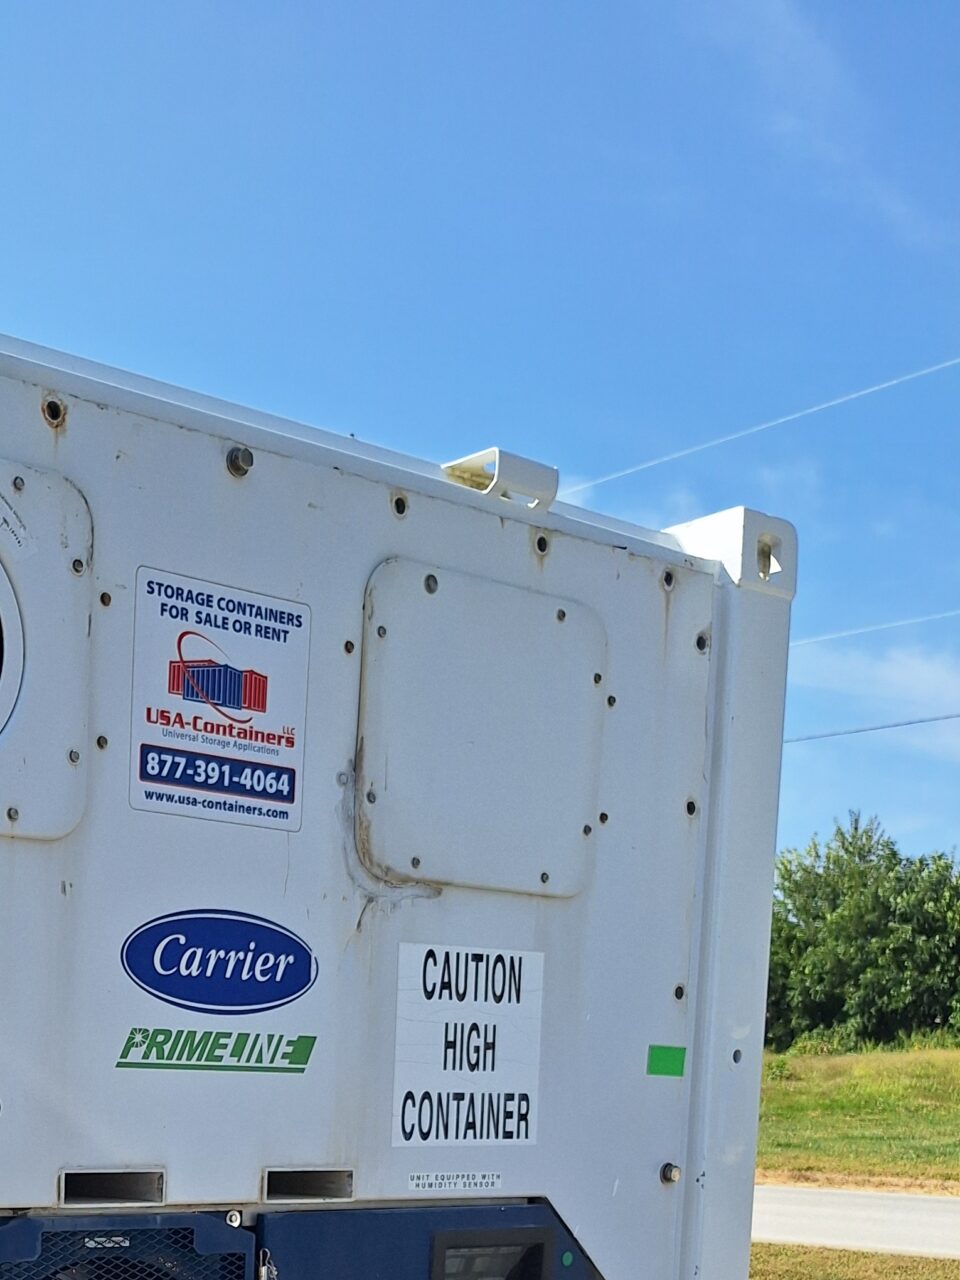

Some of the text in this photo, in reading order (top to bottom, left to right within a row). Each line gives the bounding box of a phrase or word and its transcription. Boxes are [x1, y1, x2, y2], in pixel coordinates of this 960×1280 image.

[146, 580, 303, 628] STORAGE CONTAINERS
[160, 603, 290, 643] FOR SALE OR RENT
[146, 706, 295, 749] USA-Containers
[162, 728, 280, 756] Universal Storage Applications
[282, 725, 296, 736] LLC
[146, 752, 290, 796] 877-391-4064
[144, 788, 289, 820] www.usa-containers.com
[152, 934, 295, 982] Carrier
[422, 949, 522, 1004] CAUTION
[119, 1027, 317, 1066] PRIMELINE
[443, 1022, 496, 1072] HIGH
[401, 1091, 530, 1141] CONTAINER
[410, 1174, 430, 1182] UNIT
[435, 1174, 476, 1182] EQUIPPED
